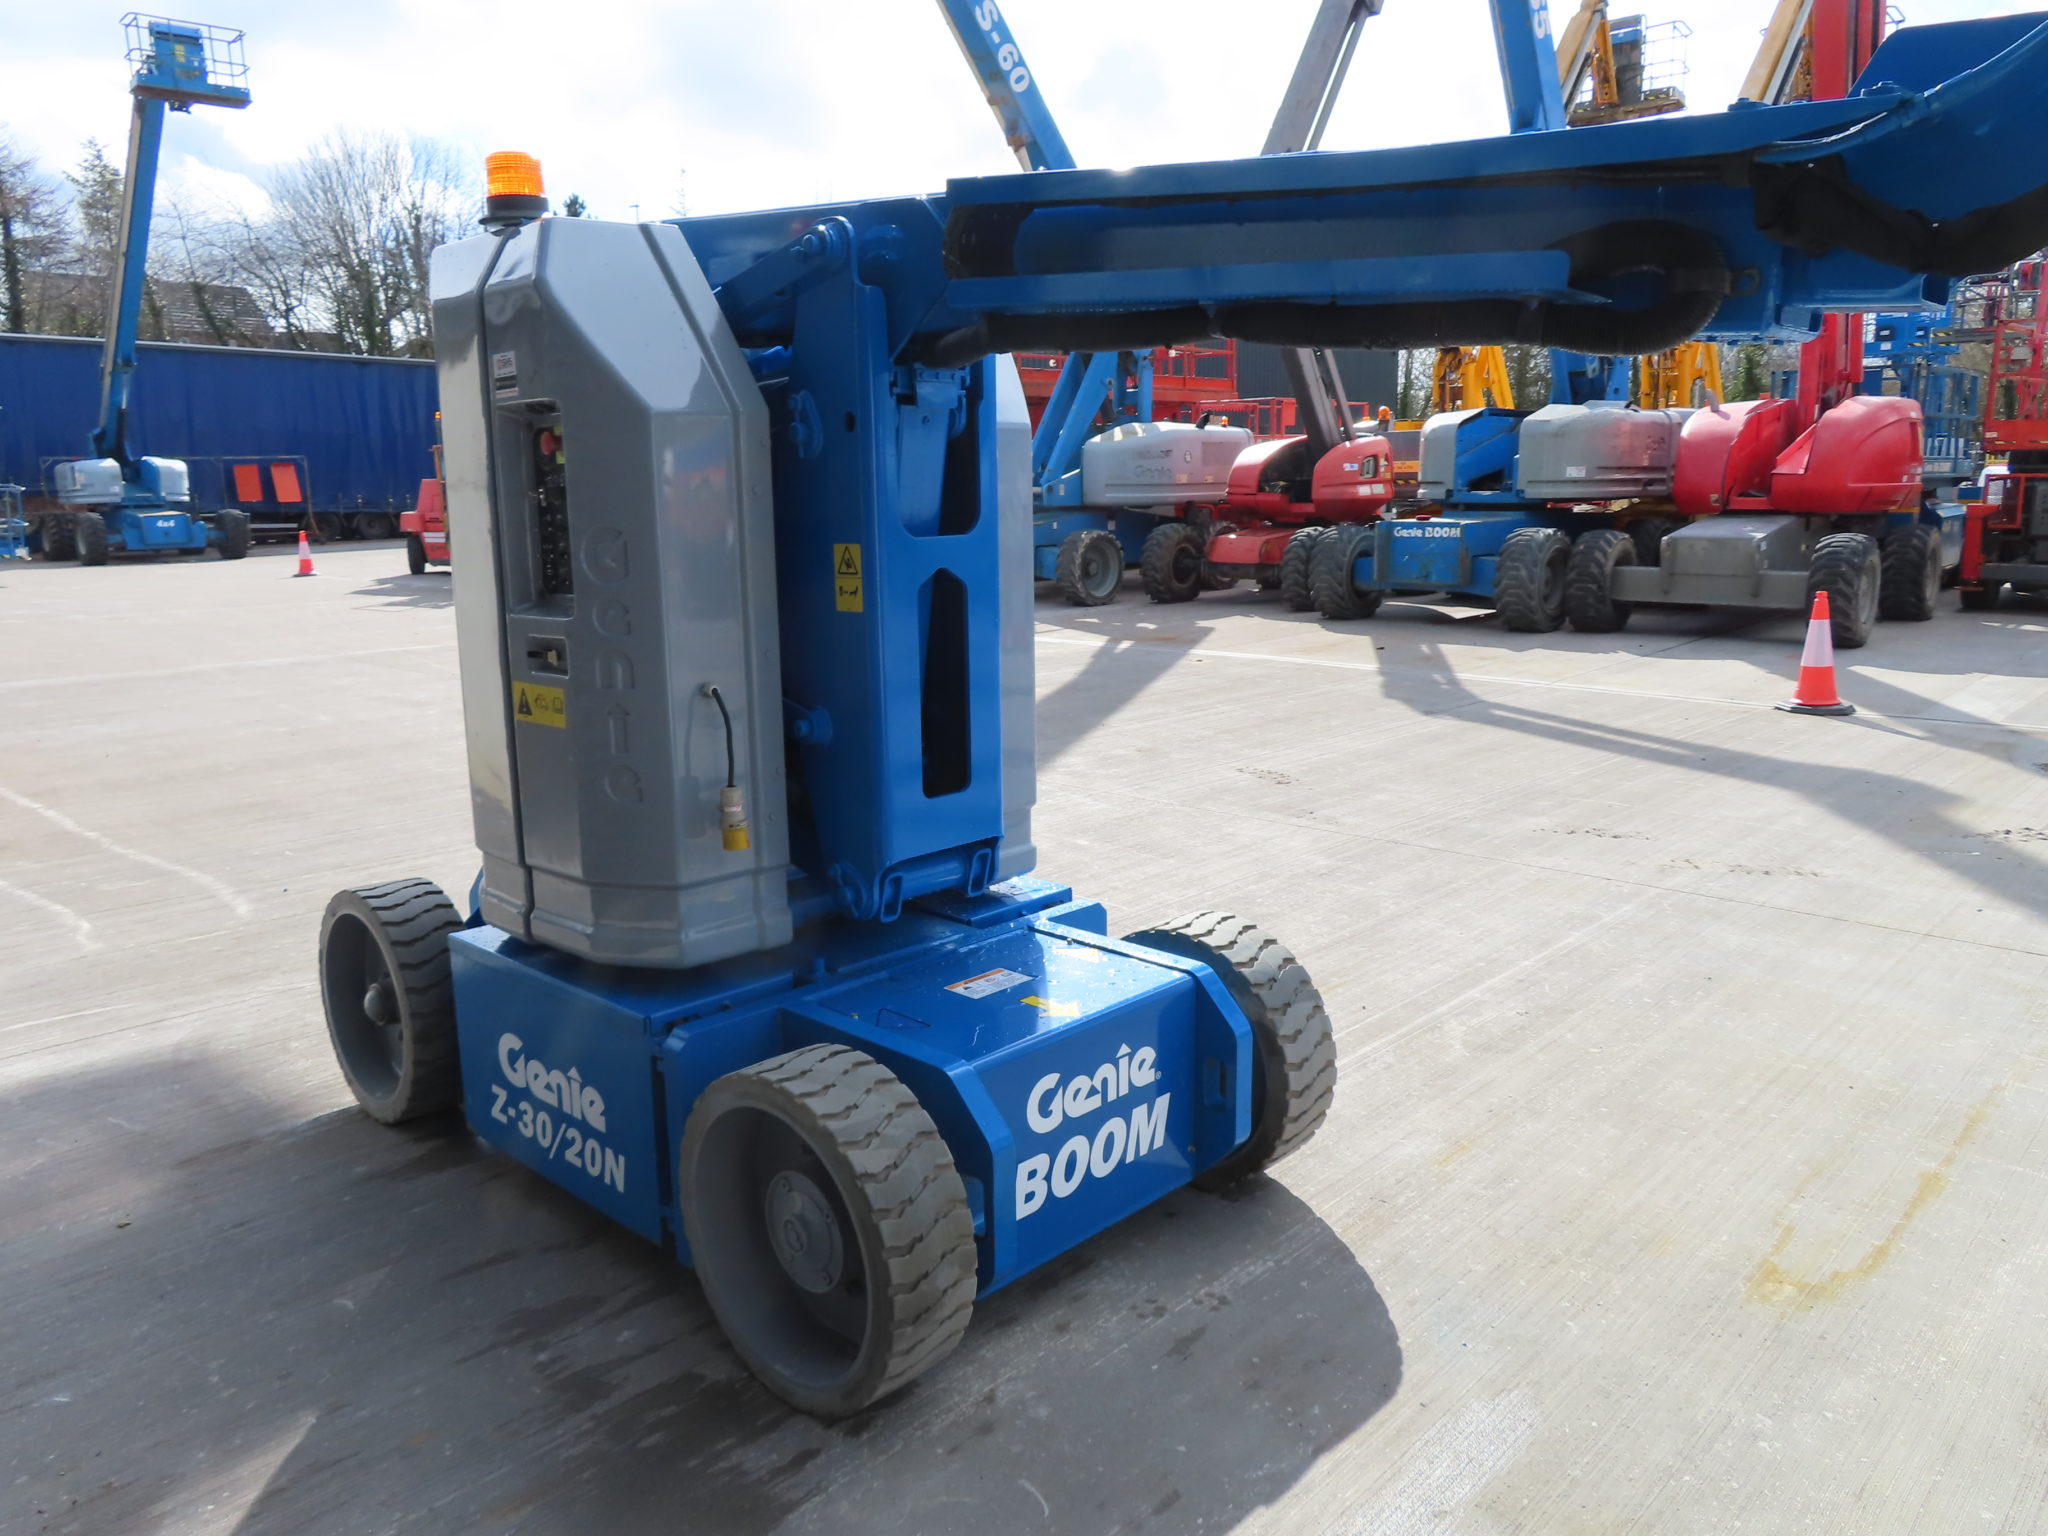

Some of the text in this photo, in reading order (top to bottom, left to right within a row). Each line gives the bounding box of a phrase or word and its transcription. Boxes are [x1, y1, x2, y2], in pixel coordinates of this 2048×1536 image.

[975, 0, 1030, 92] S-60
[156, 520, 176, 528] 4x4
[1393, 526, 1461, 538] Genie BOOM
[497, 1032, 607, 1133] Genie
[490, 1084, 626, 1194] Z-30/20N
[1015, 1092, 1171, 1221] BOOM
